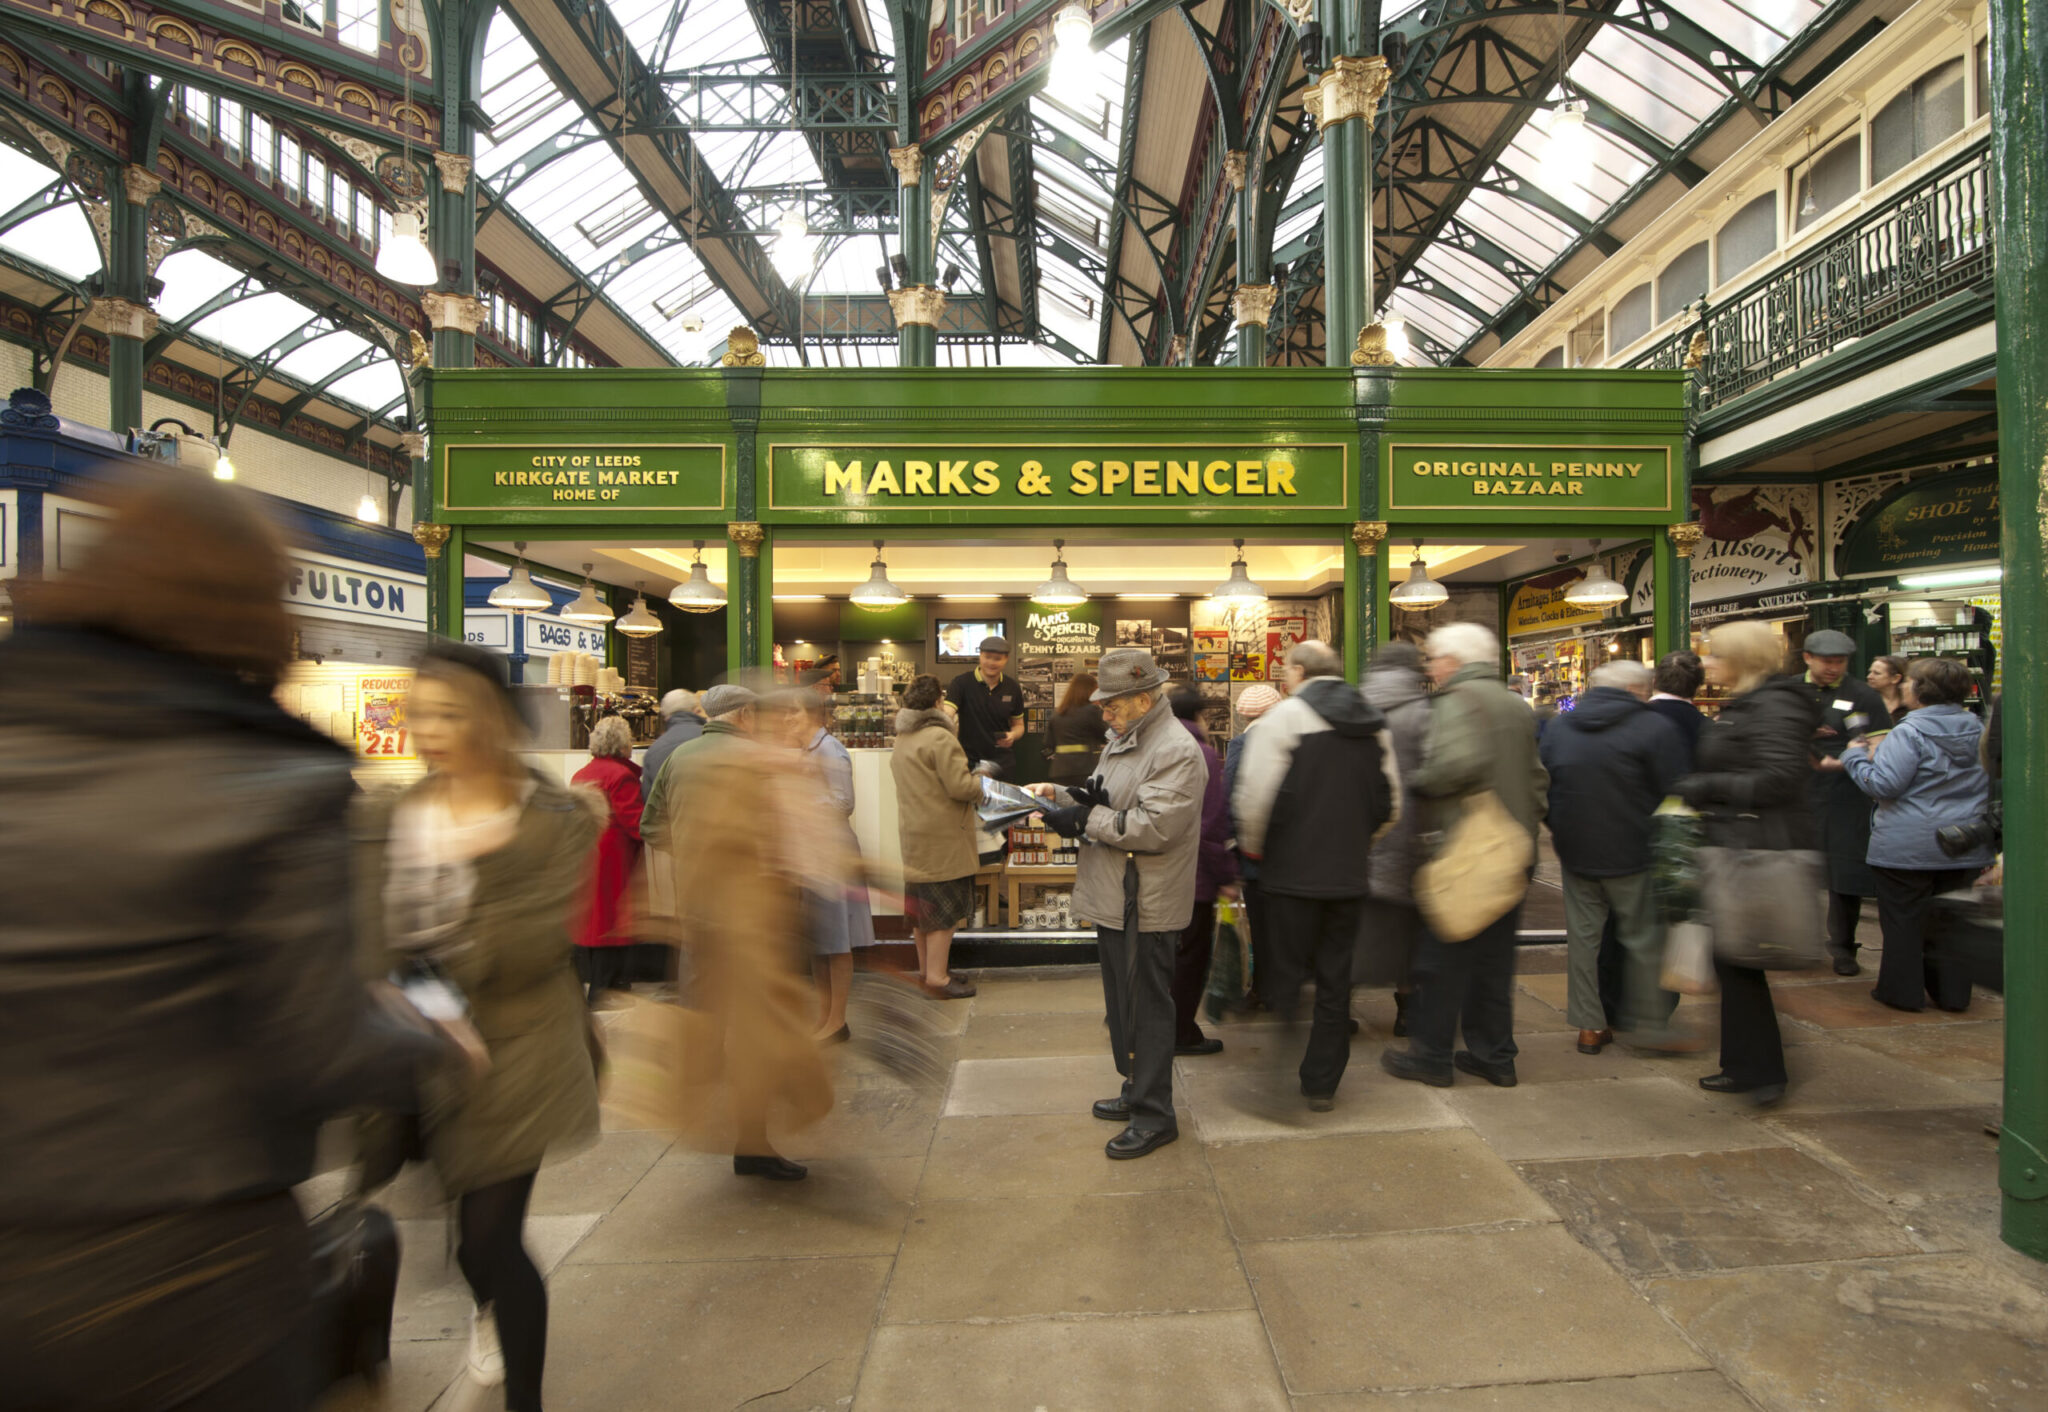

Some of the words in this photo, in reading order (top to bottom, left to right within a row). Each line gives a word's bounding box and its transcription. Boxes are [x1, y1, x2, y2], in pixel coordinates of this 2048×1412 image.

[532, 456, 567, 467] CITY
[571, 456, 591, 467] OF
[595, 456, 641, 467] LEEDS
[1411, 461, 1543, 476] ORIGINAL
[1550, 463, 1643, 477] PENNY
[494, 471, 591, 486] KIRKGATE
[597, 471, 680, 486] MARKET
[823, 460, 1001, 496] MARKS
[1017, 460, 1052, 496] &
[1068, 460, 1299, 497] SPENCER
[552, 489, 596, 501] HOME
[600, 489, 620, 501] OF
[1472, 480, 1584, 495] BAZAAR
[1905, 498, 1974, 522] SHOE
[1931, 530, 1988, 543] Precision
[1881, 548, 1942, 563] Engraving
[288, 567, 404, 613] FULTON
[1719, 602, 1740, 613] FREE
[1758, 591, 1809, 609] SWEETS
[1026, 611, 1070, 629] MARKS
[539, 624, 571, 647] BAGS
[577, 631, 588, 649] &
[1033, 629, 1043, 639] &
[1042, 622, 1087, 641] SPENCER
[1022, 642, 1055, 654] PENNY
[1055, 643, 1101, 654] BAZAARS
[361, 679, 411, 690] REDUCED
[365, 734, 381, 754] 2
